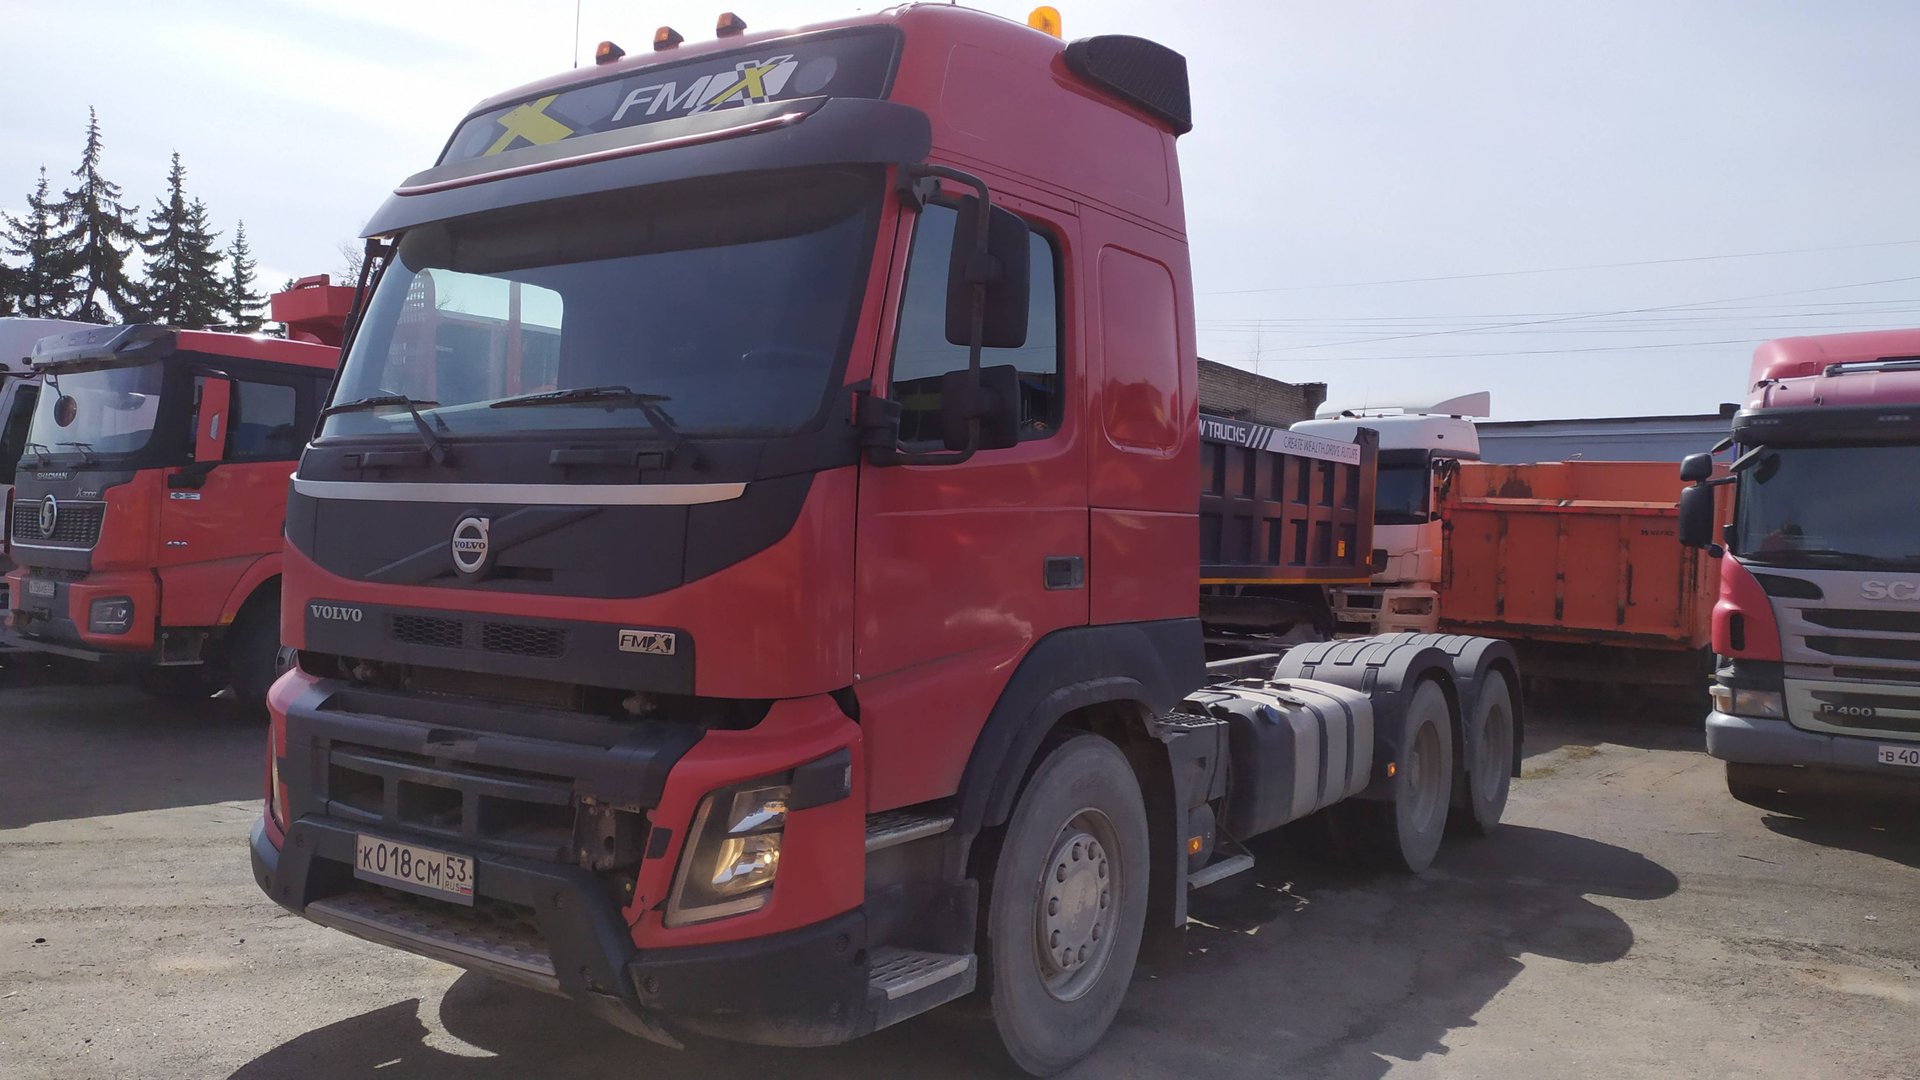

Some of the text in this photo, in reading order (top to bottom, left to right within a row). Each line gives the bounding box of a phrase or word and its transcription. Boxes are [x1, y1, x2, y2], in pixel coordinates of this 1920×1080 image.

[1207, 420, 1246, 444] TRUCKS
[1283, 436, 1303, 451] CREATE
[1341, 446, 1358, 460] FUTURE
[454, 541, 486, 549] VOLVO
[1860, 580, 1920, 601] SC
[310, 604, 363, 622] VOLVO
[620, 633, 673, 653] FMX
[1823, 705, 1872, 717] P 400
[444, 881, 460, 892] RUS
